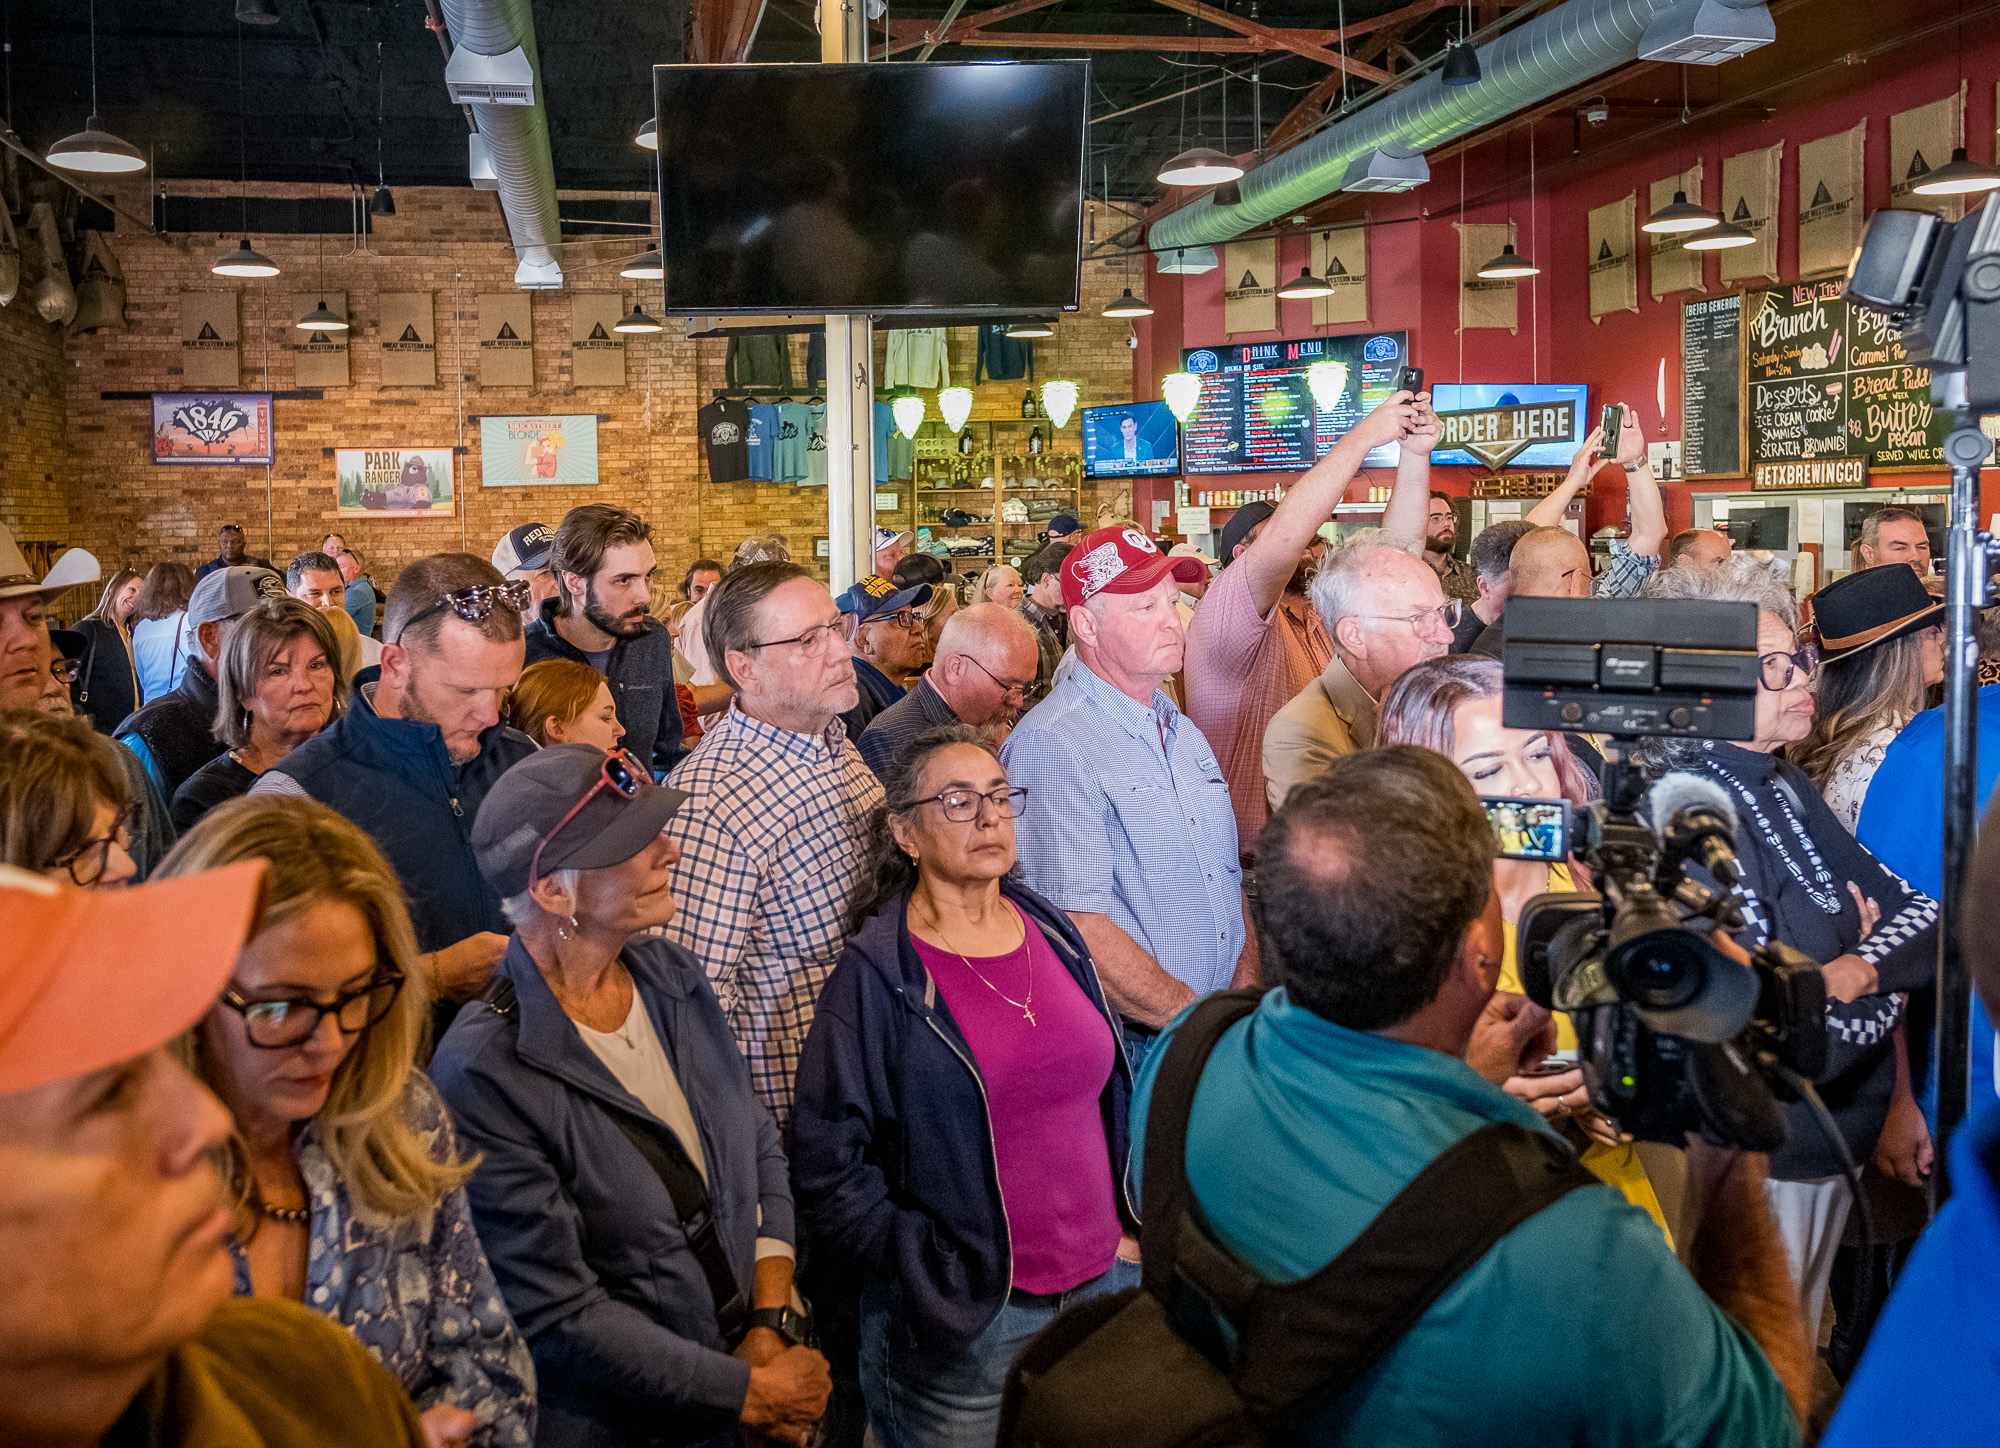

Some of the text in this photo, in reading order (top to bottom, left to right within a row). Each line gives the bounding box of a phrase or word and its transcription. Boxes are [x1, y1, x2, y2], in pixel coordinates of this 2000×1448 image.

[1835, 199, 1850, 210] MALT
[1239, 288, 1261, 296] WESTERN
[1793, 283, 1817, 303] NEW
[1708, 295, 1740, 313] GENEROUS
[1758, 297, 1828, 348] Brunch
[1242, 342, 1322, 363] DRINK MENU
[1752, 348, 1780, 368] Saturday
[1851, 345, 1889, 366] Caramel
[1852, 367, 1932, 399] Bread Pudd
[1756, 380, 1822, 410] Desserts
[1877, 393, 1888, 401] THE
[1892, 391, 1910, 399] WEEK
[176, 406, 243, 432] 1846
[1512, 407, 1569, 439] HERE
[1757, 414, 1772, 428] ICE
[1774, 411, 1803, 427] CREAM
[1848, 418, 1862, 439] $8
[1865, 399, 1933, 443] Butter
[196, 429, 221, 443] IPA
[508, 431, 540, 440] BLONDE
[1762, 426, 1801, 442] SAMMIES
[1761, 441, 1801, 458] SCRATCH
[1804, 436, 1846, 453] BROWNIES
[1877, 450, 1904, 462] SERVED
[365, 452, 401, 470] PARK
[1228, 464, 1243, 473] today
[365, 471, 401, 484] RANGER
[1757, 461, 1863, 486] #ETXBREWINGCO
[522, 527, 542, 547] RED
